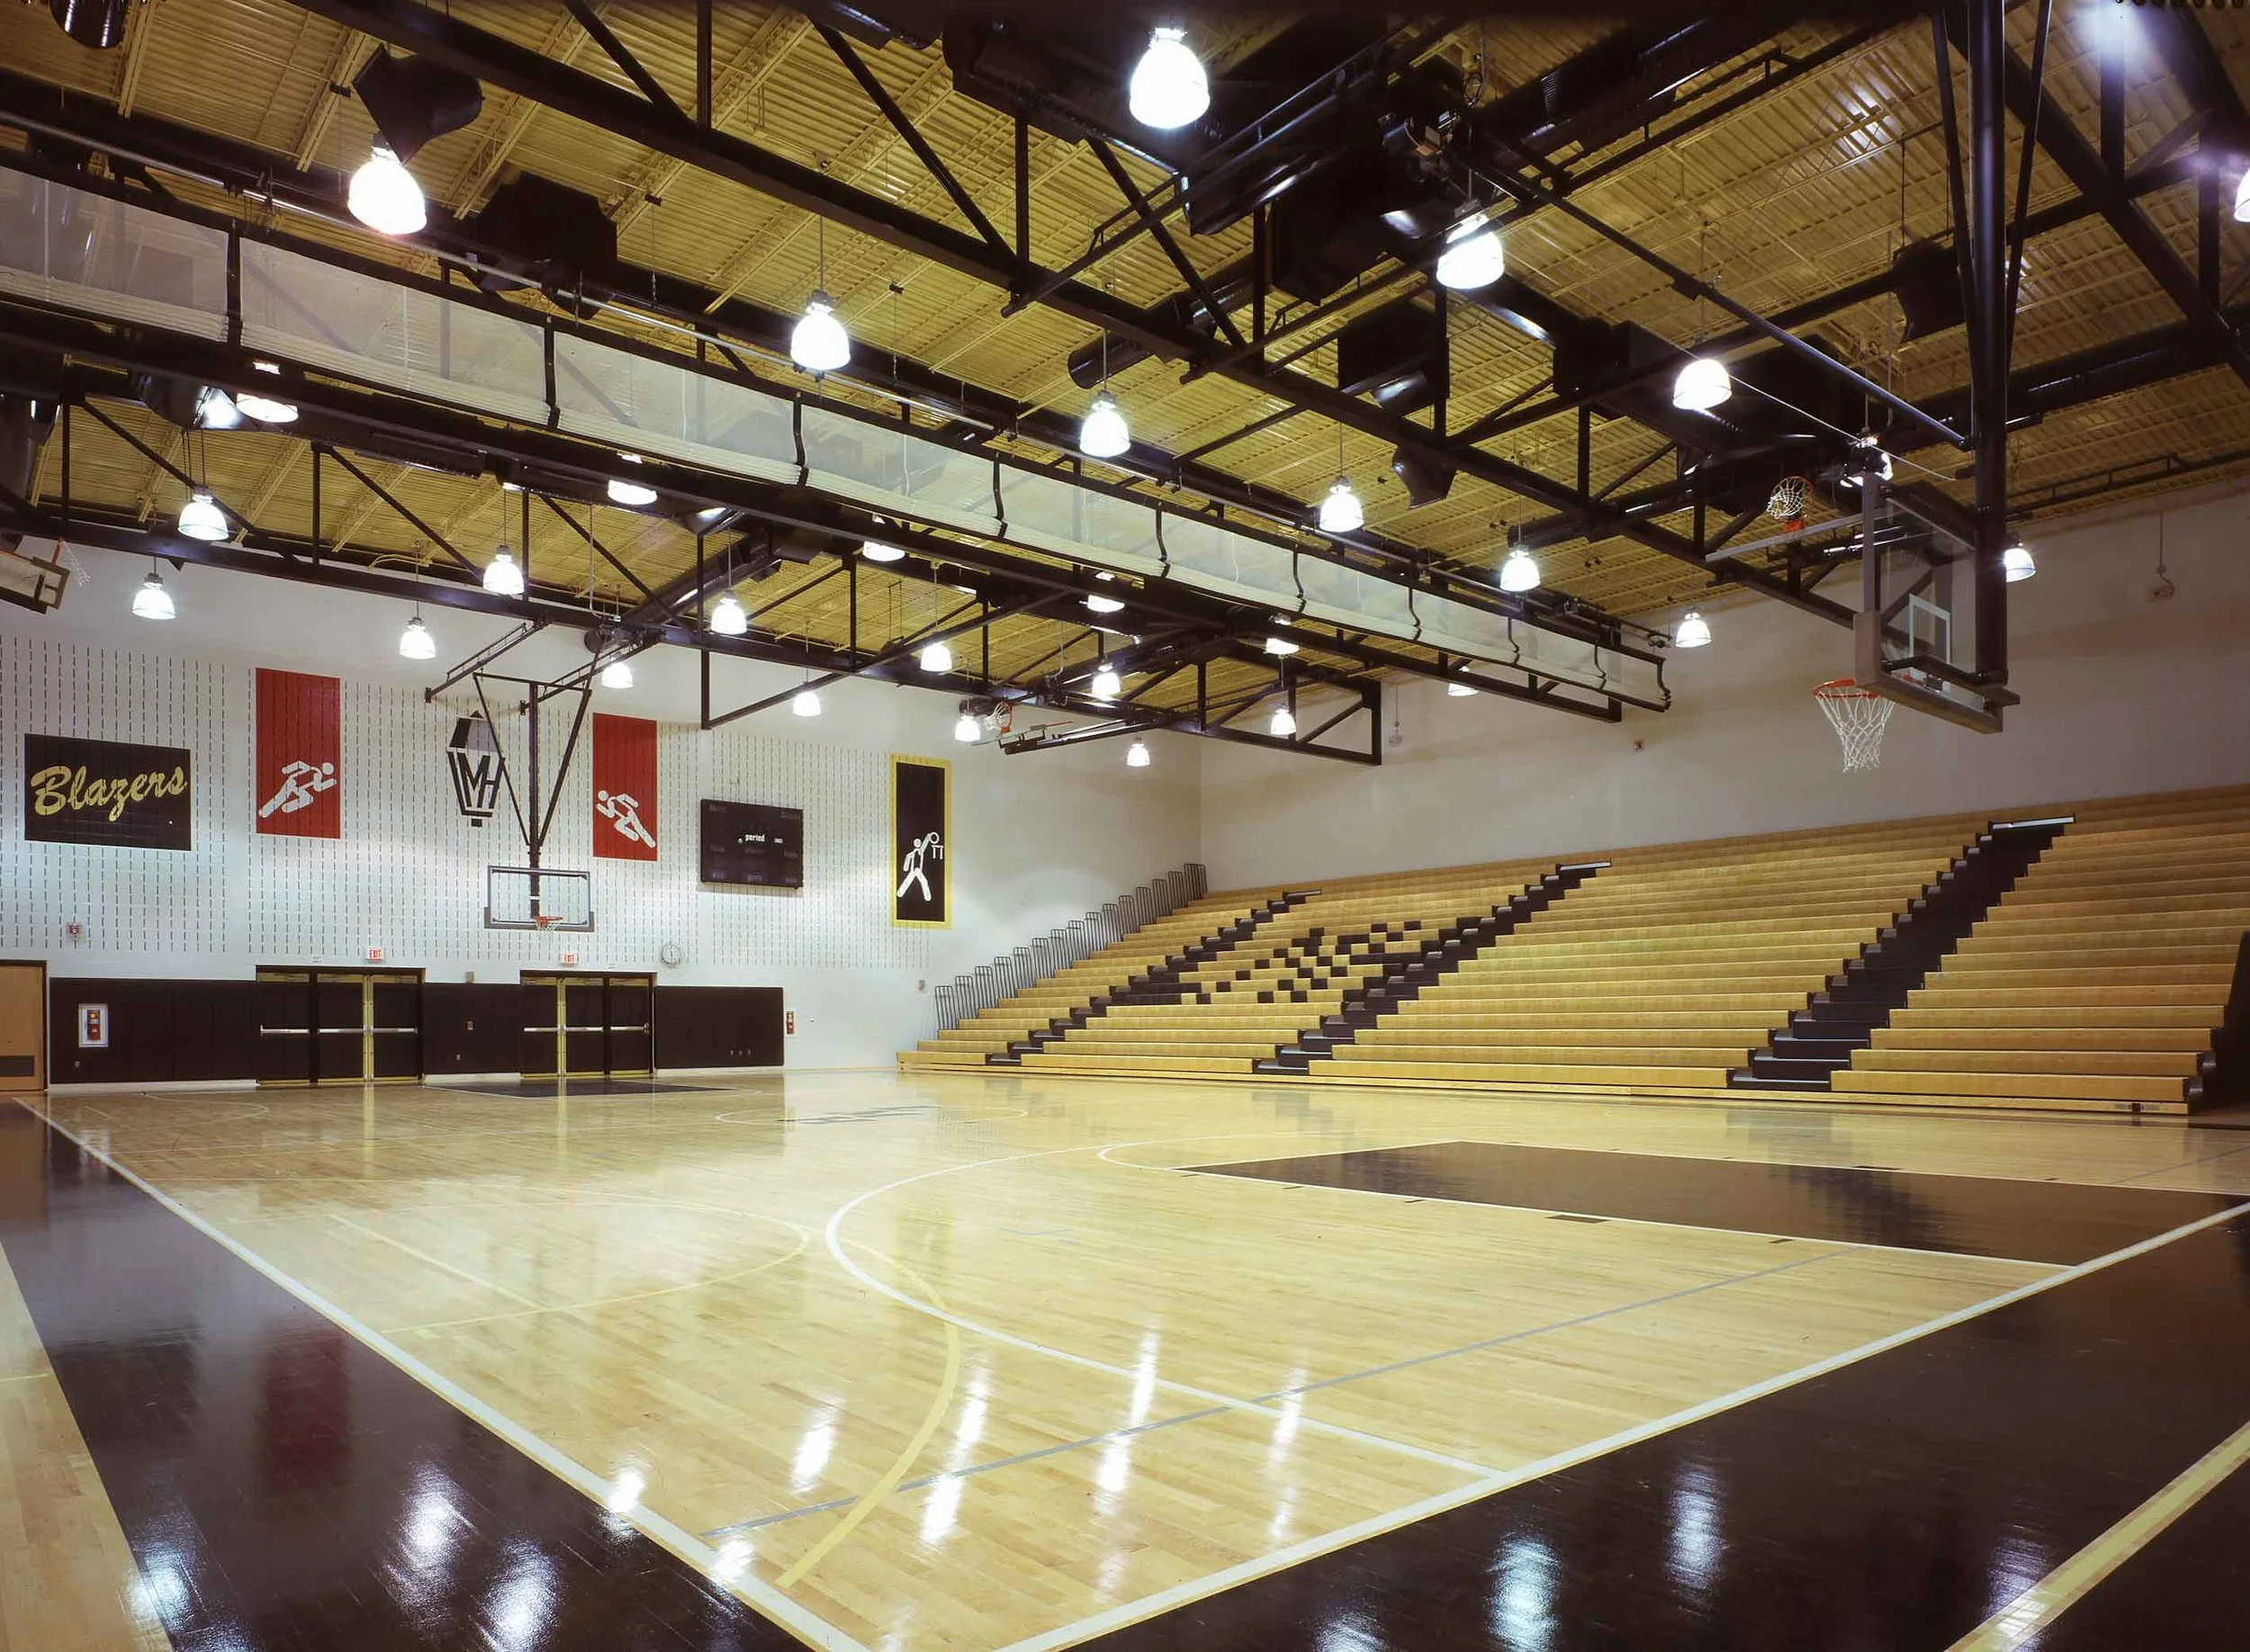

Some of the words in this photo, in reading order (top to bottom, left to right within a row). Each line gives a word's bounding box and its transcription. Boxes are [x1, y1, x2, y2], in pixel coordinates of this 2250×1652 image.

[31, 765, 187, 822] Blazers
[744, 833, 765, 842] period
[368, 949, 382, 959] EXIT
